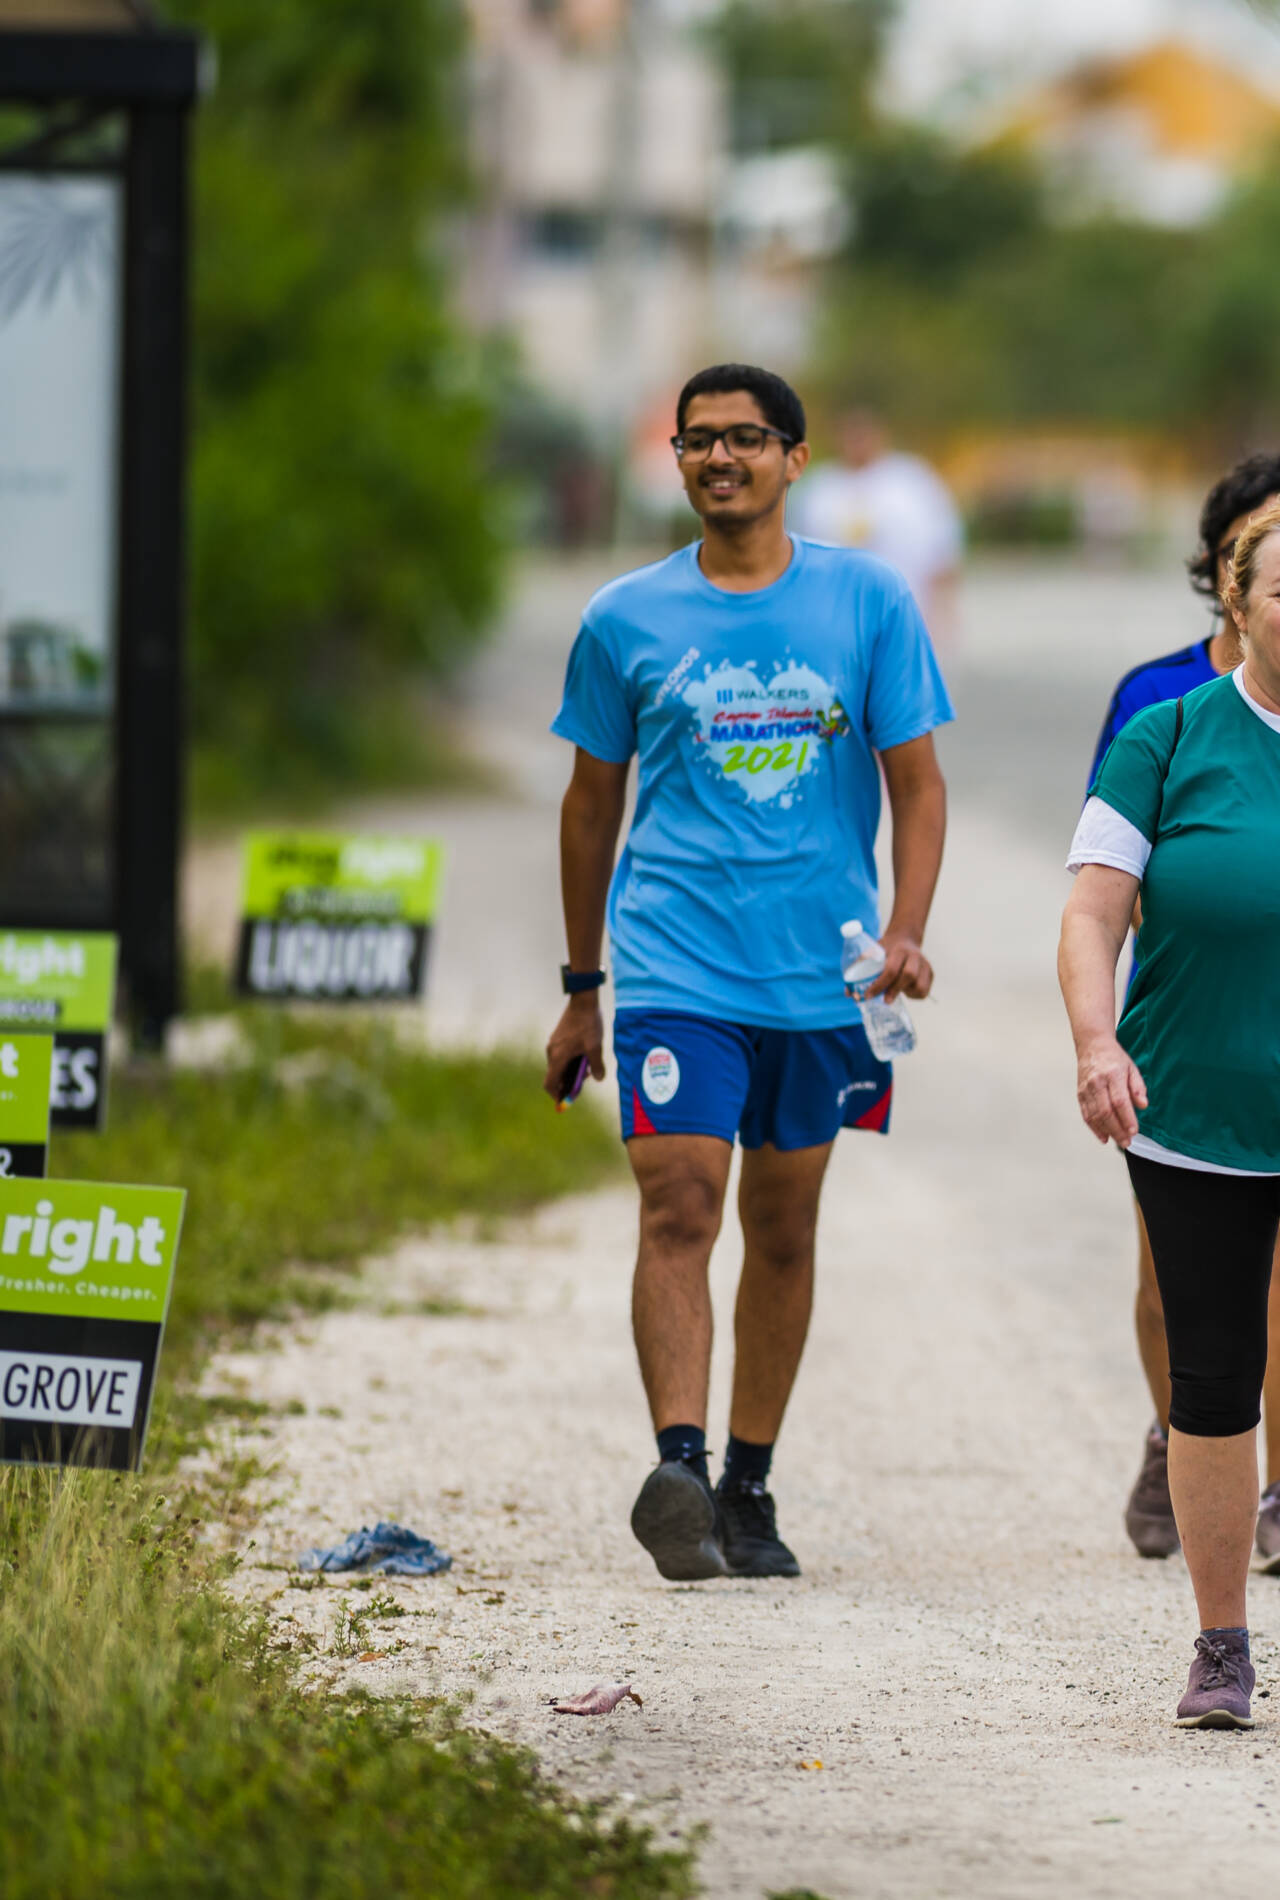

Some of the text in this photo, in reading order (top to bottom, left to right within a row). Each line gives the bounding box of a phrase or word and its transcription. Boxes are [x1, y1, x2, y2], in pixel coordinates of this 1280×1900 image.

[736, 687, 810, 701] WALKERS
[710, 720, 820, 741] MARATHON
[722, 741, 809, 775] 2021
[0, 932, 84, 984] ight
[2, 1199, 166, 1276] right
[75, 1281, 158, 1301] Cheaper.
[4, 1363, 129, 1416] GROVE
